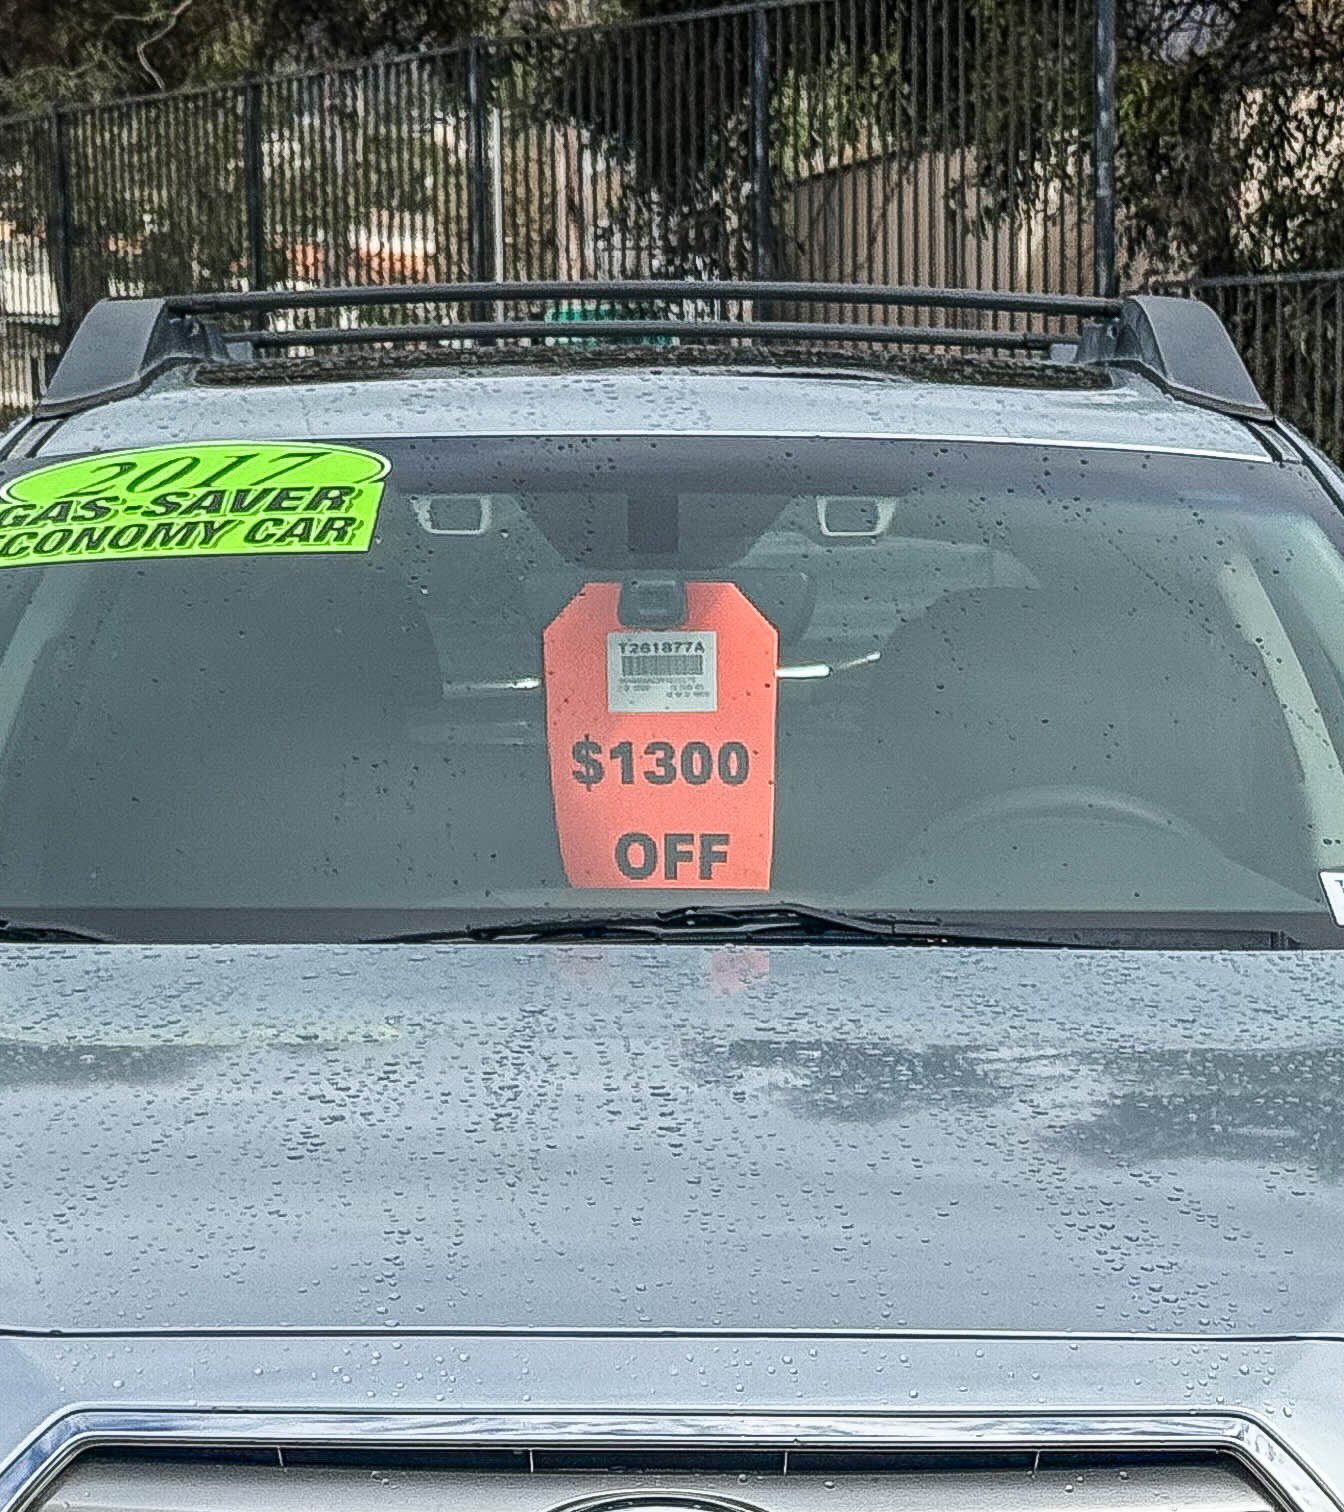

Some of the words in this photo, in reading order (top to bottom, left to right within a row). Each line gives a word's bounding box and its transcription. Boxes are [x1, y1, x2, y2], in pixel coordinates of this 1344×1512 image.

[65, 452, 333, 499] 2017
[243, 516, 362, 546] CAR
[572, 734, 750, 792] $1300
[615, 833, 730, 880] OFF
